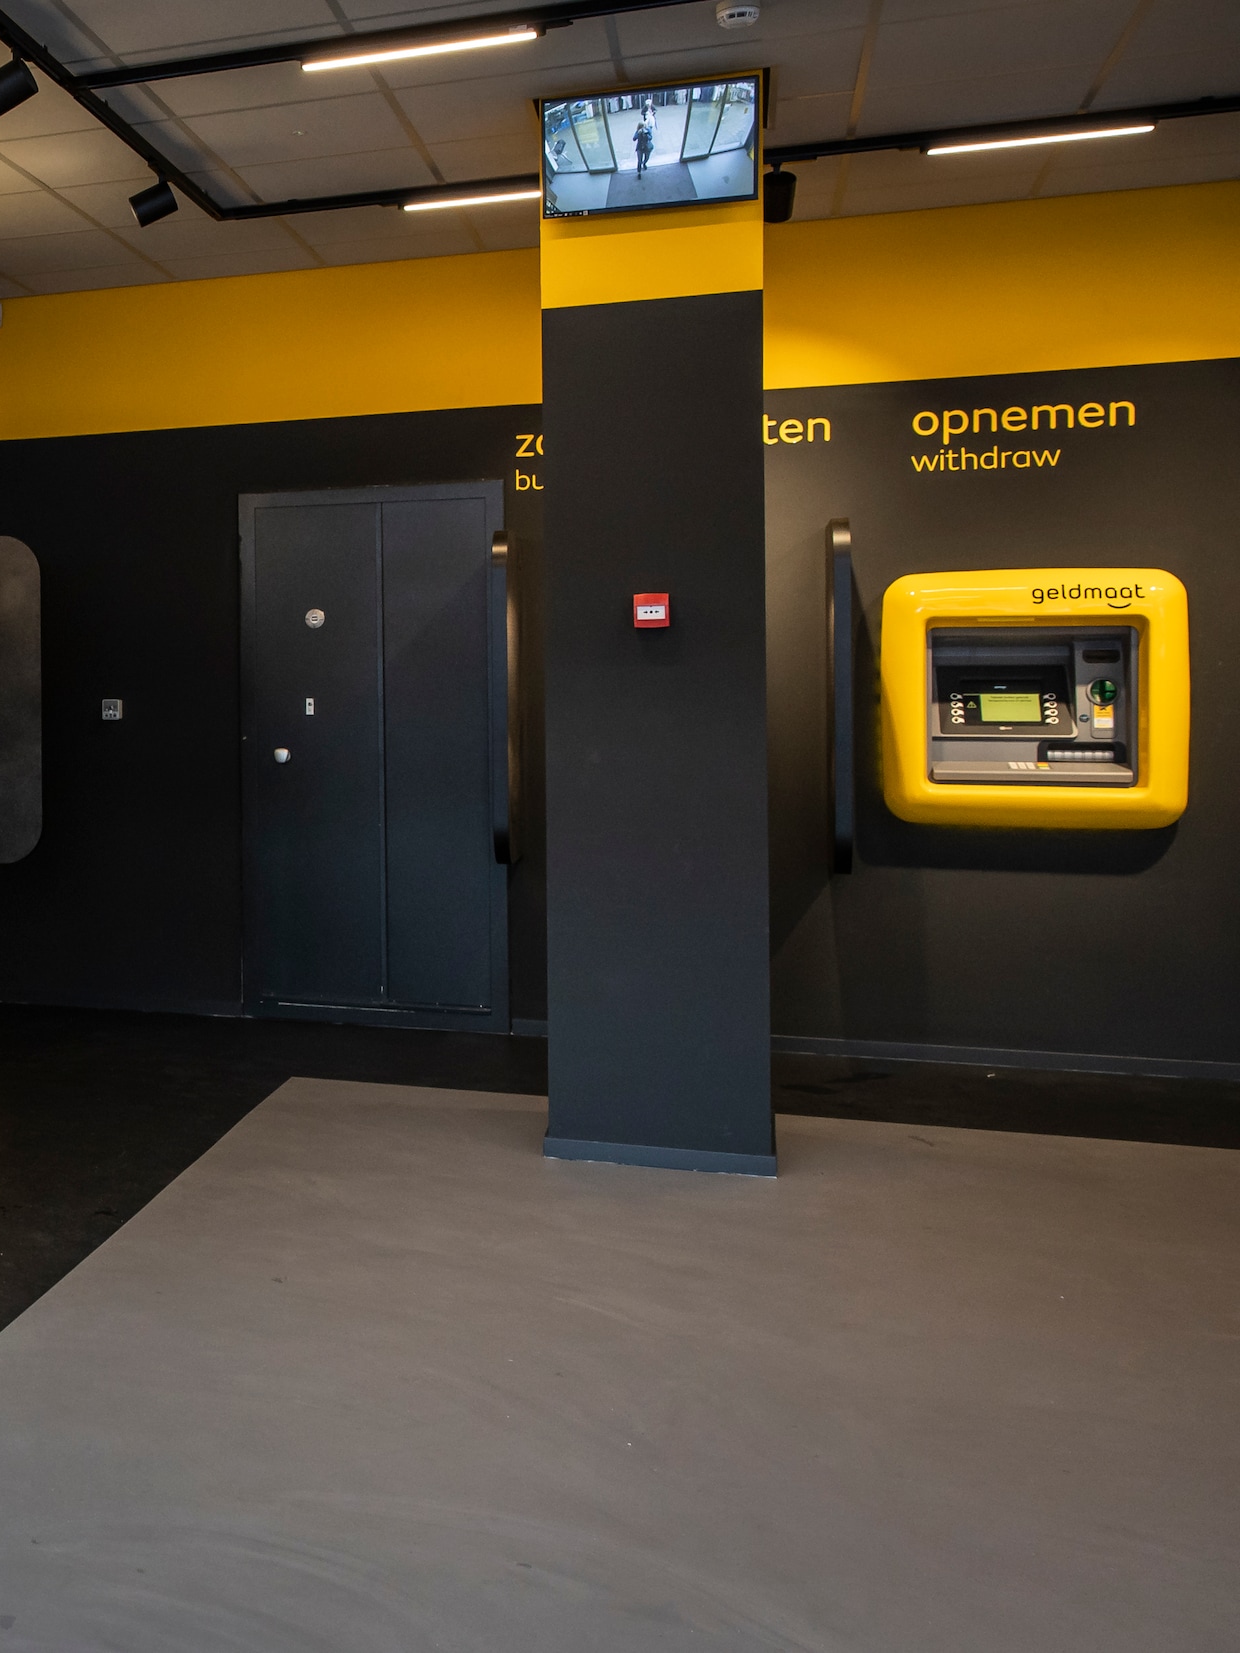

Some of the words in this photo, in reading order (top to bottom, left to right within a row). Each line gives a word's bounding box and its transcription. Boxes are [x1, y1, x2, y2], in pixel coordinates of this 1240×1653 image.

[762, 413, 831, 445] ten
[912, 400, 1137, 446] opnemen
[910, 445, 1061, 473] withdraw
[1032, 584, 1146, 605] geldmaat
